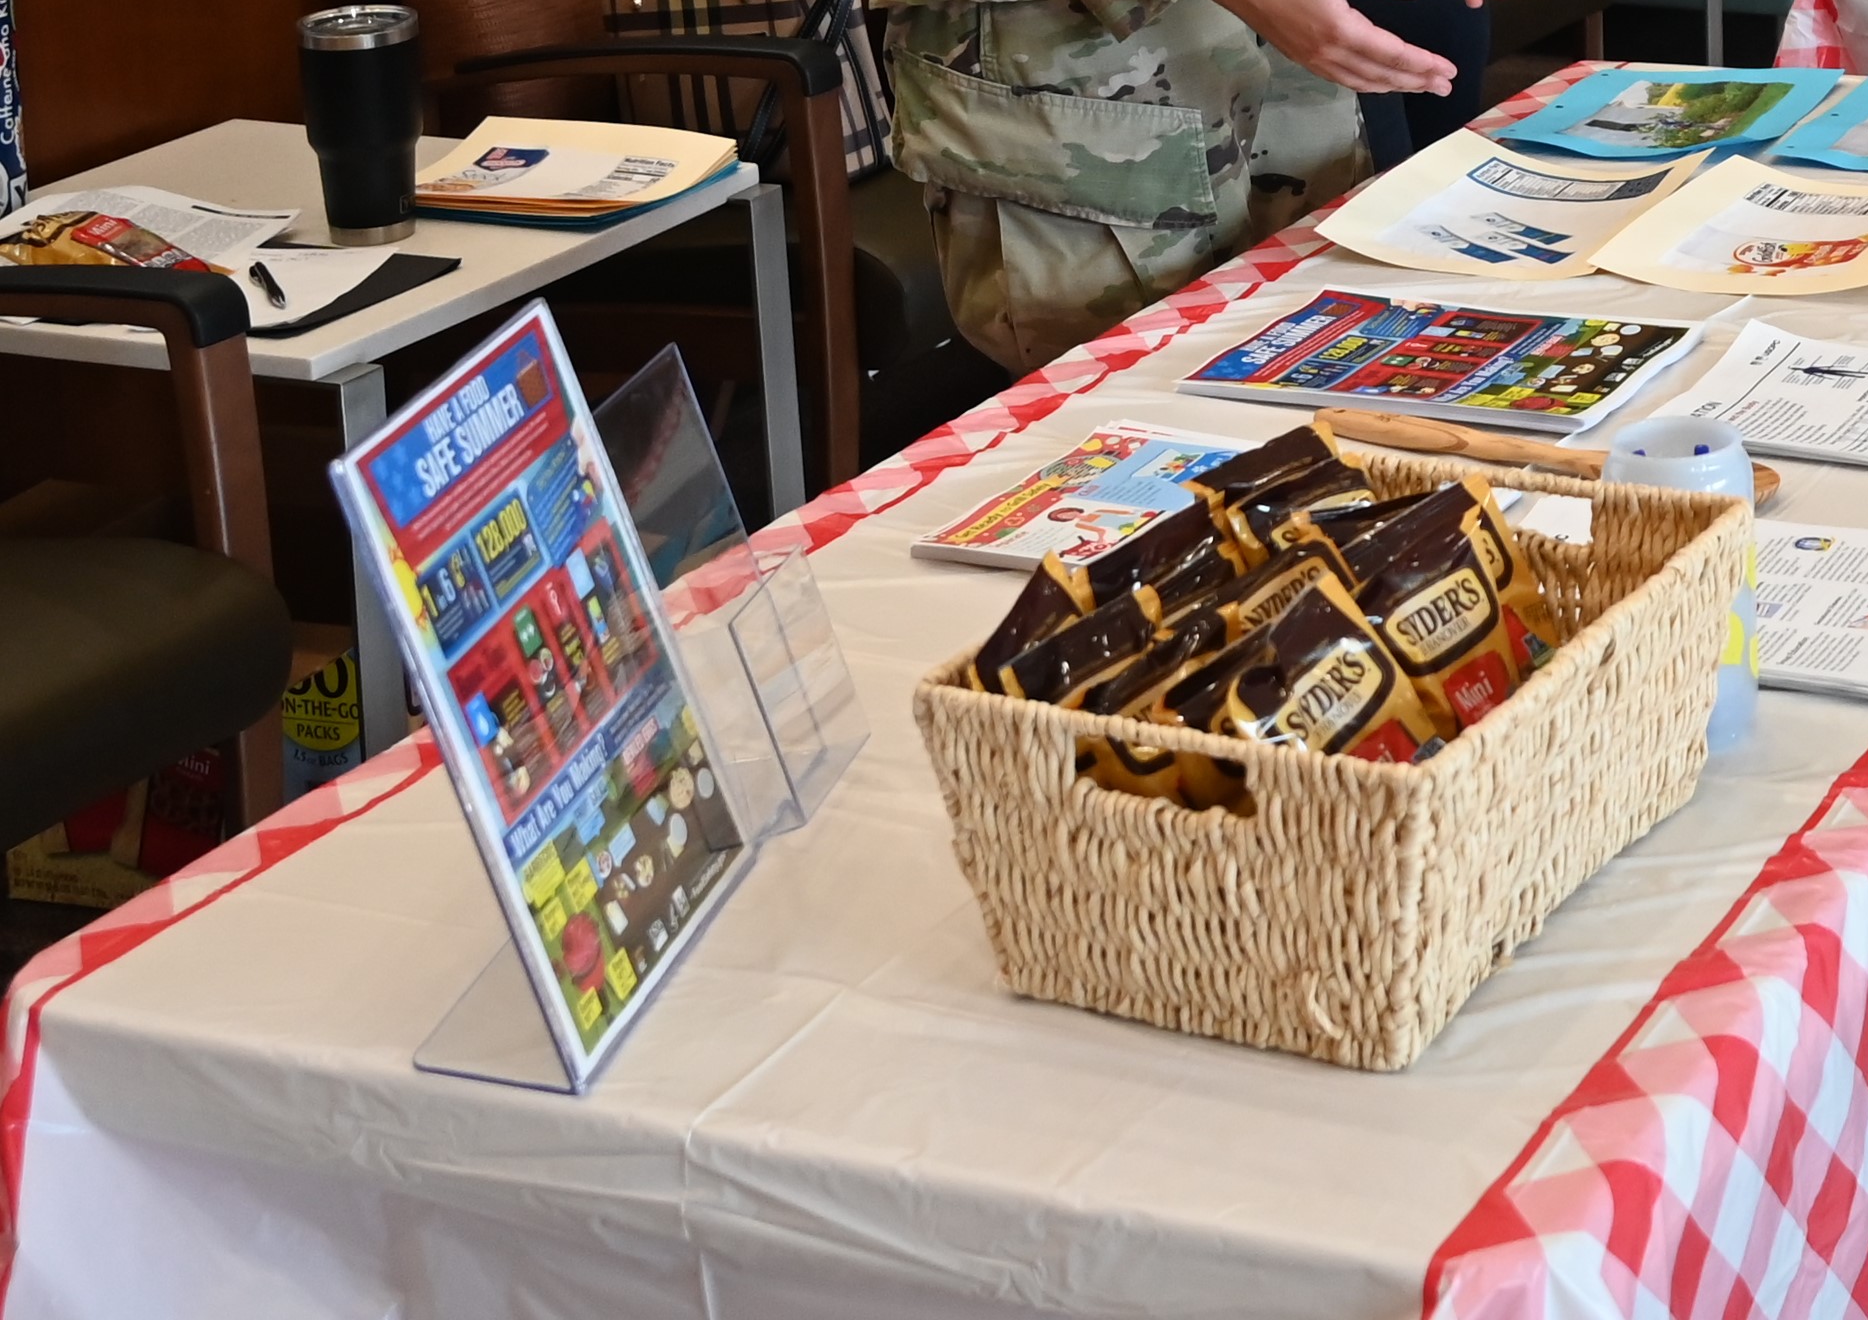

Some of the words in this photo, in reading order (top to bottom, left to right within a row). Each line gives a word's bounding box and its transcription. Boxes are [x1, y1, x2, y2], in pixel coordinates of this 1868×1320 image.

[1238, 345, 1289, 364] SAFE
[1268, 314, 1337, 346] SUMMER
[422, 402, 457, 446] HAVE
[458, 372, 491, 416] FOOD
[414, 438, 462, 498] SAFE
[452, 380, 526, 467] SUMMER
[474, 497, 528, 565] 128,000
[436, 564, 458, 606] 6
[281, 697, 360, 720] N-THE-GO
[1455, 670, 1494, 712] Mini
[296, 723, 341, 742] PACKS
[318, 752, 349, 768] BAGS
[510, 818, 539, 859] What
[534, 797, 557, 832] Are
